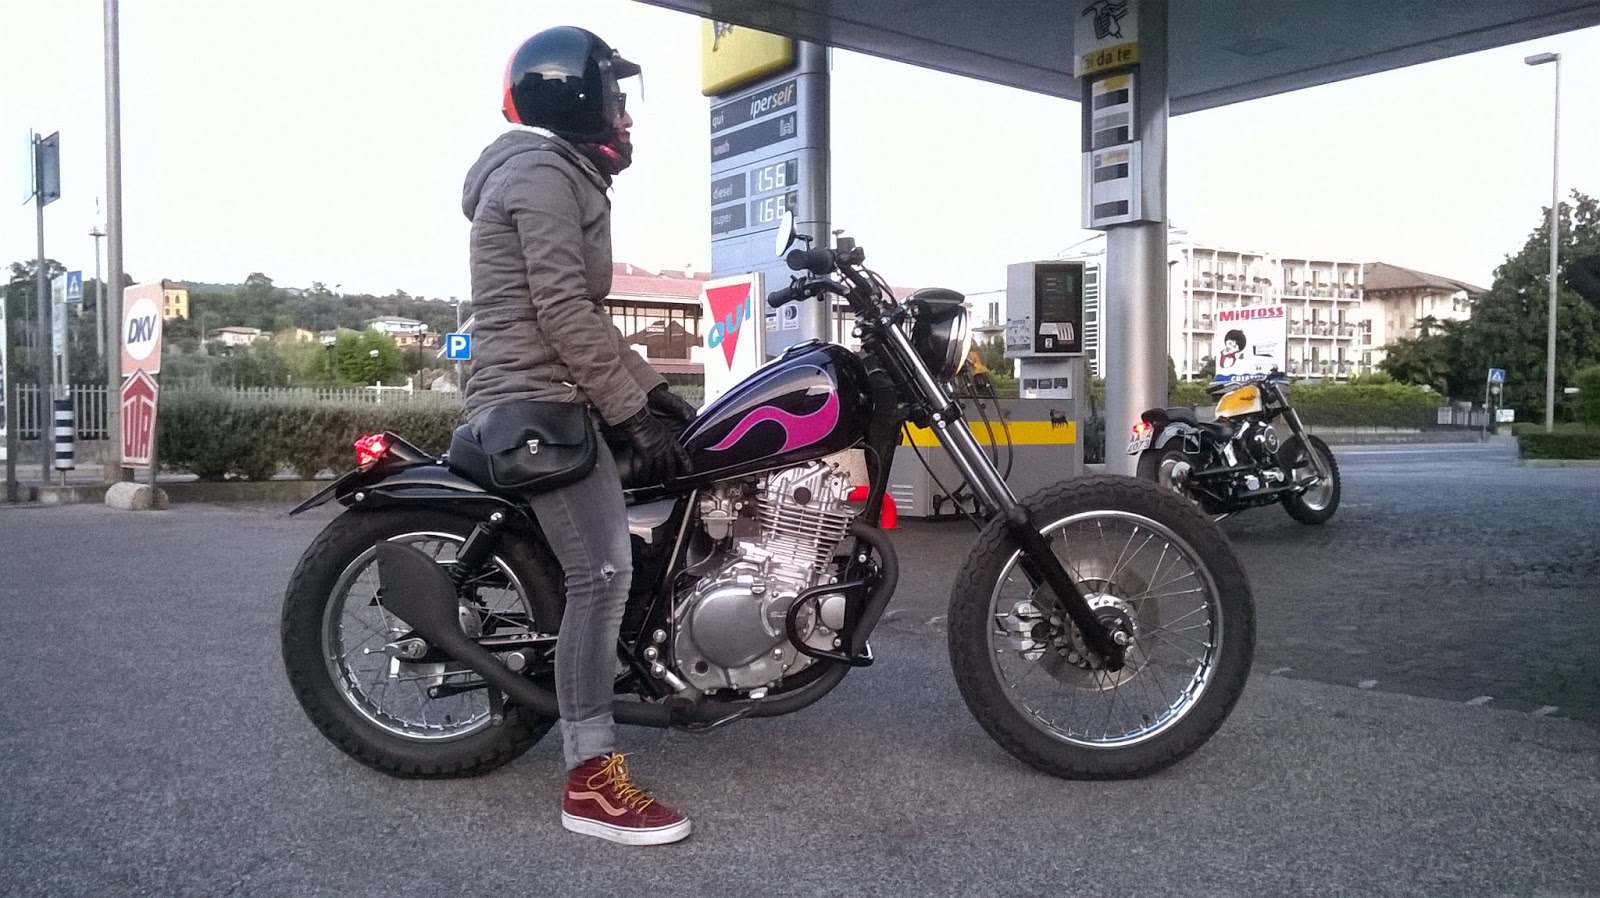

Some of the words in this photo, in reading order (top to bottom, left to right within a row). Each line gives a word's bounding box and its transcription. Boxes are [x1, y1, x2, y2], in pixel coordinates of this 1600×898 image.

[1096, 49, 1113, 66] da
[1117, 48, 1131, 61] te
[712, 111, 724, 129] qui
[750, 84, 795, 119] iperself
[712, 183, 733, 199] diesel
[712, 213, 732, 227] super
[707, 296, 751, 349] QUI
[1219, 306, 1284, 322] Migross
[127, 314, 157, 345] DKV
[450, 336, 467, 358] P
